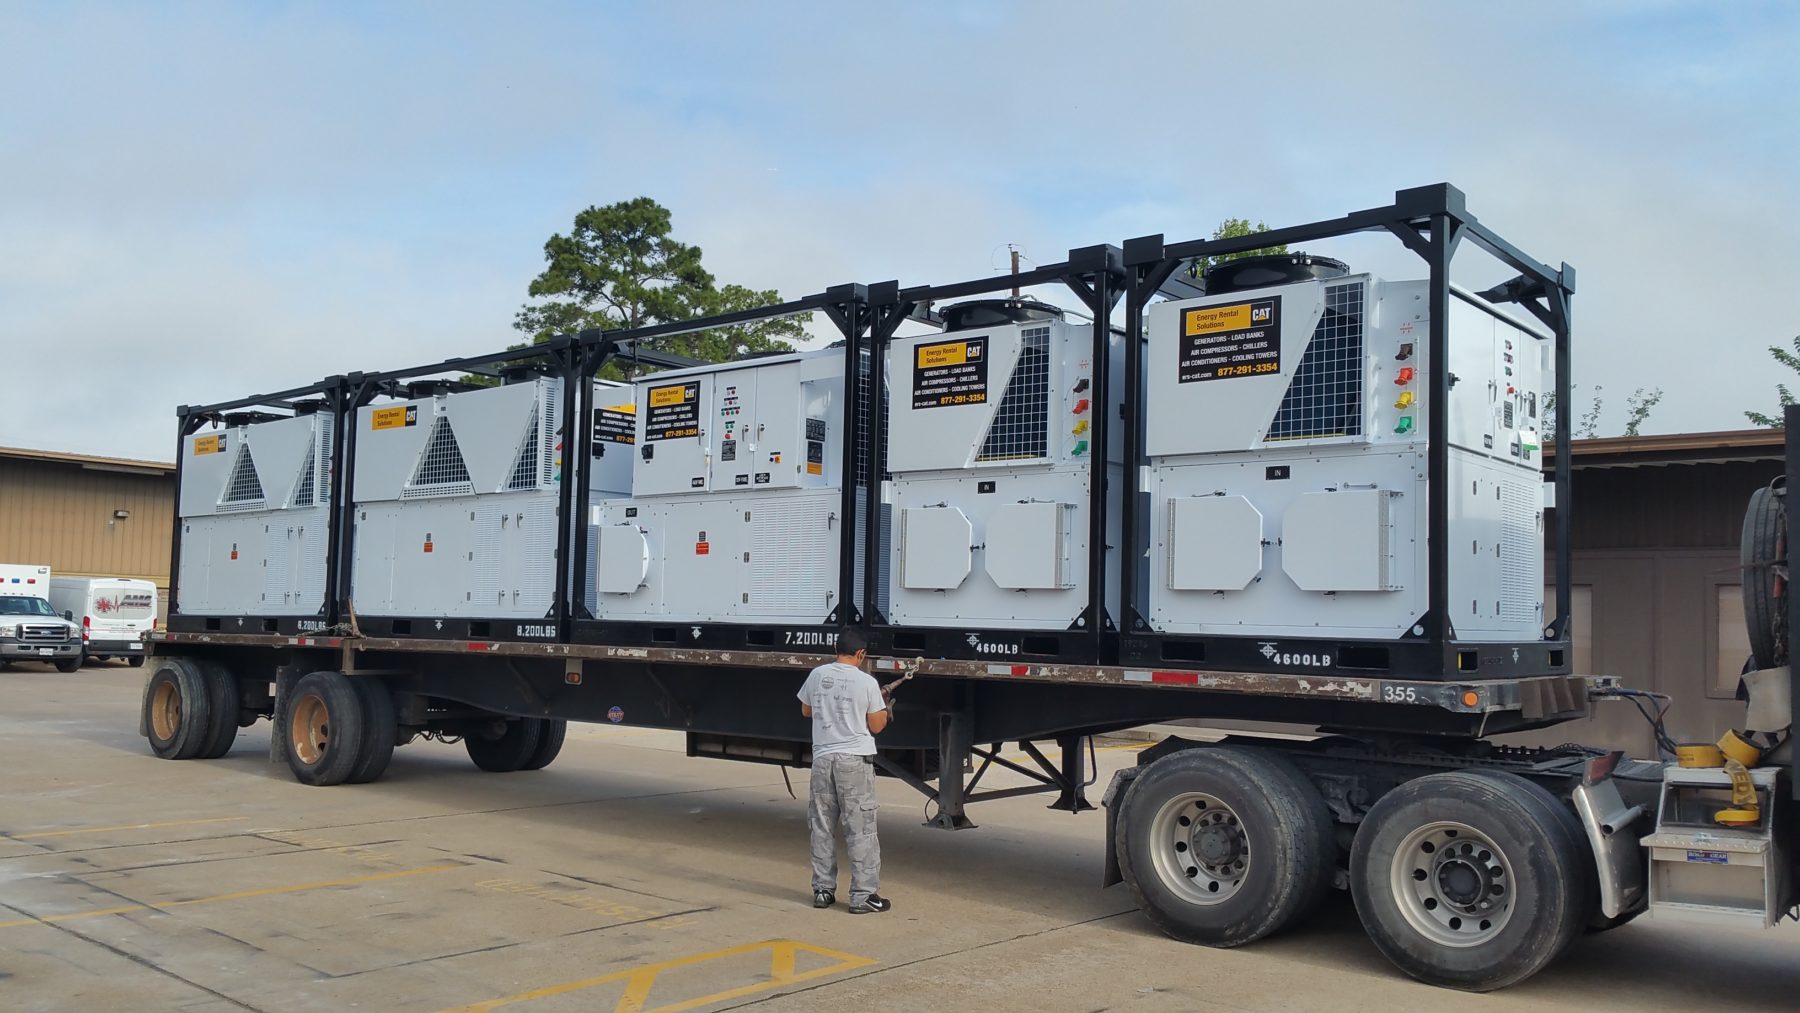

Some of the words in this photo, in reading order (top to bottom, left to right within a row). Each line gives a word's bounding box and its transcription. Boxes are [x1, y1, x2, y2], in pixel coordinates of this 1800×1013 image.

[1196, 313, 1217, 322] Energy
[1218, 310, 1239, 318] Rental
[1252, 307, 1271, 321] CAT
[1196, 321, 1224, 330] Solutions
[1194, 336, 1227, 346] GENERATORS
[967, 346, 980, 357] CAT
[1200, 345, 1238, 355] COMPRESSORS
[1242, 342, 1268, 350] CHILLERS
[1191, 356, 1228, 366] CONDITIONERS
[1232, 354, 1254, 362] COOLING
[1255, 351, 1278, 359] TOWERS
[1218, 362, 1278, 376] 877-291-3354
[940, 394, 985, 404] 877-291-3354
[406, 410, 416, 421] CAT
[976, 643, 1018, 654] 4600LB
[1273, 653, 1331, 666] 4600LB
[1384, 686, 1416, 701] 355
